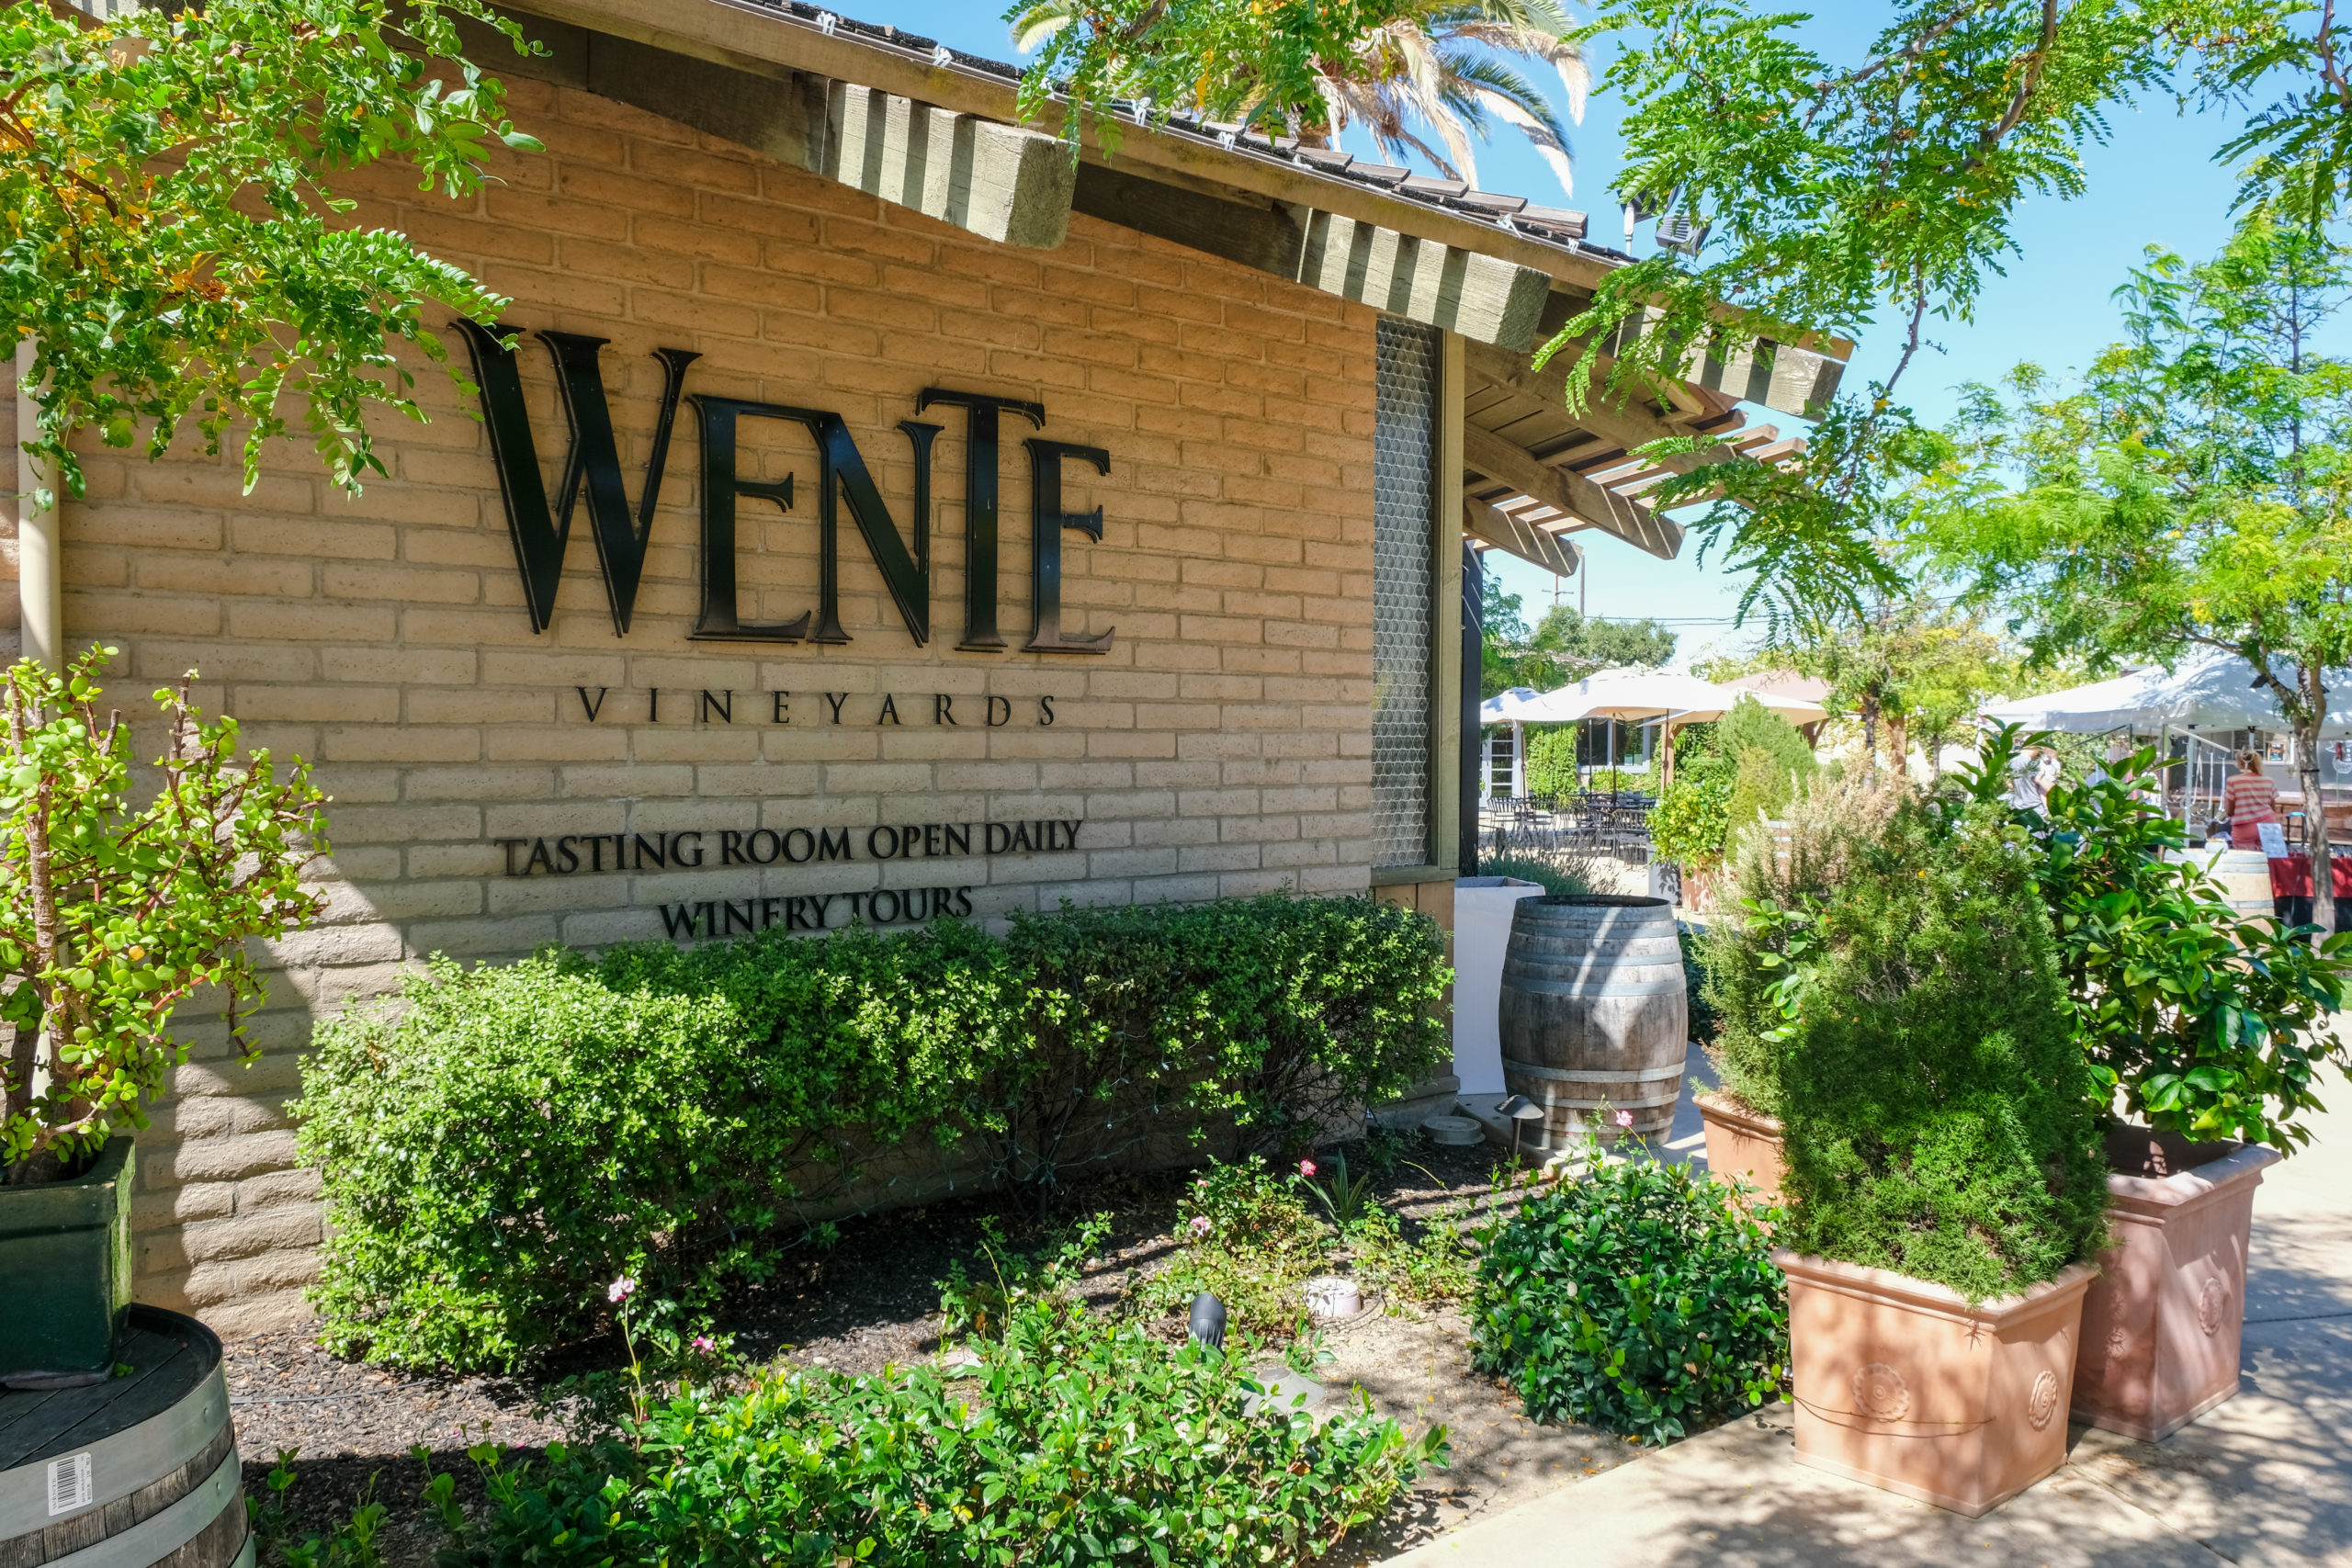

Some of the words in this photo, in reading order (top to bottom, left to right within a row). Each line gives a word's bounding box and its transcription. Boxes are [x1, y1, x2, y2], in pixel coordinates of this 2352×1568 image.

[449, 318, 1115, 654] WENTE
[575, 686, 1055, 727] VINEYARDS
[493, 831, 704, 876] TASTING
[718, 827, 854, 864] ROOM
[868, 823, 970, 859] OPEN
[985, 820, 1082, 854] DAILY
[657, 895, 833, 941] WINERY
[842, 886, 972, 923] TOURS
